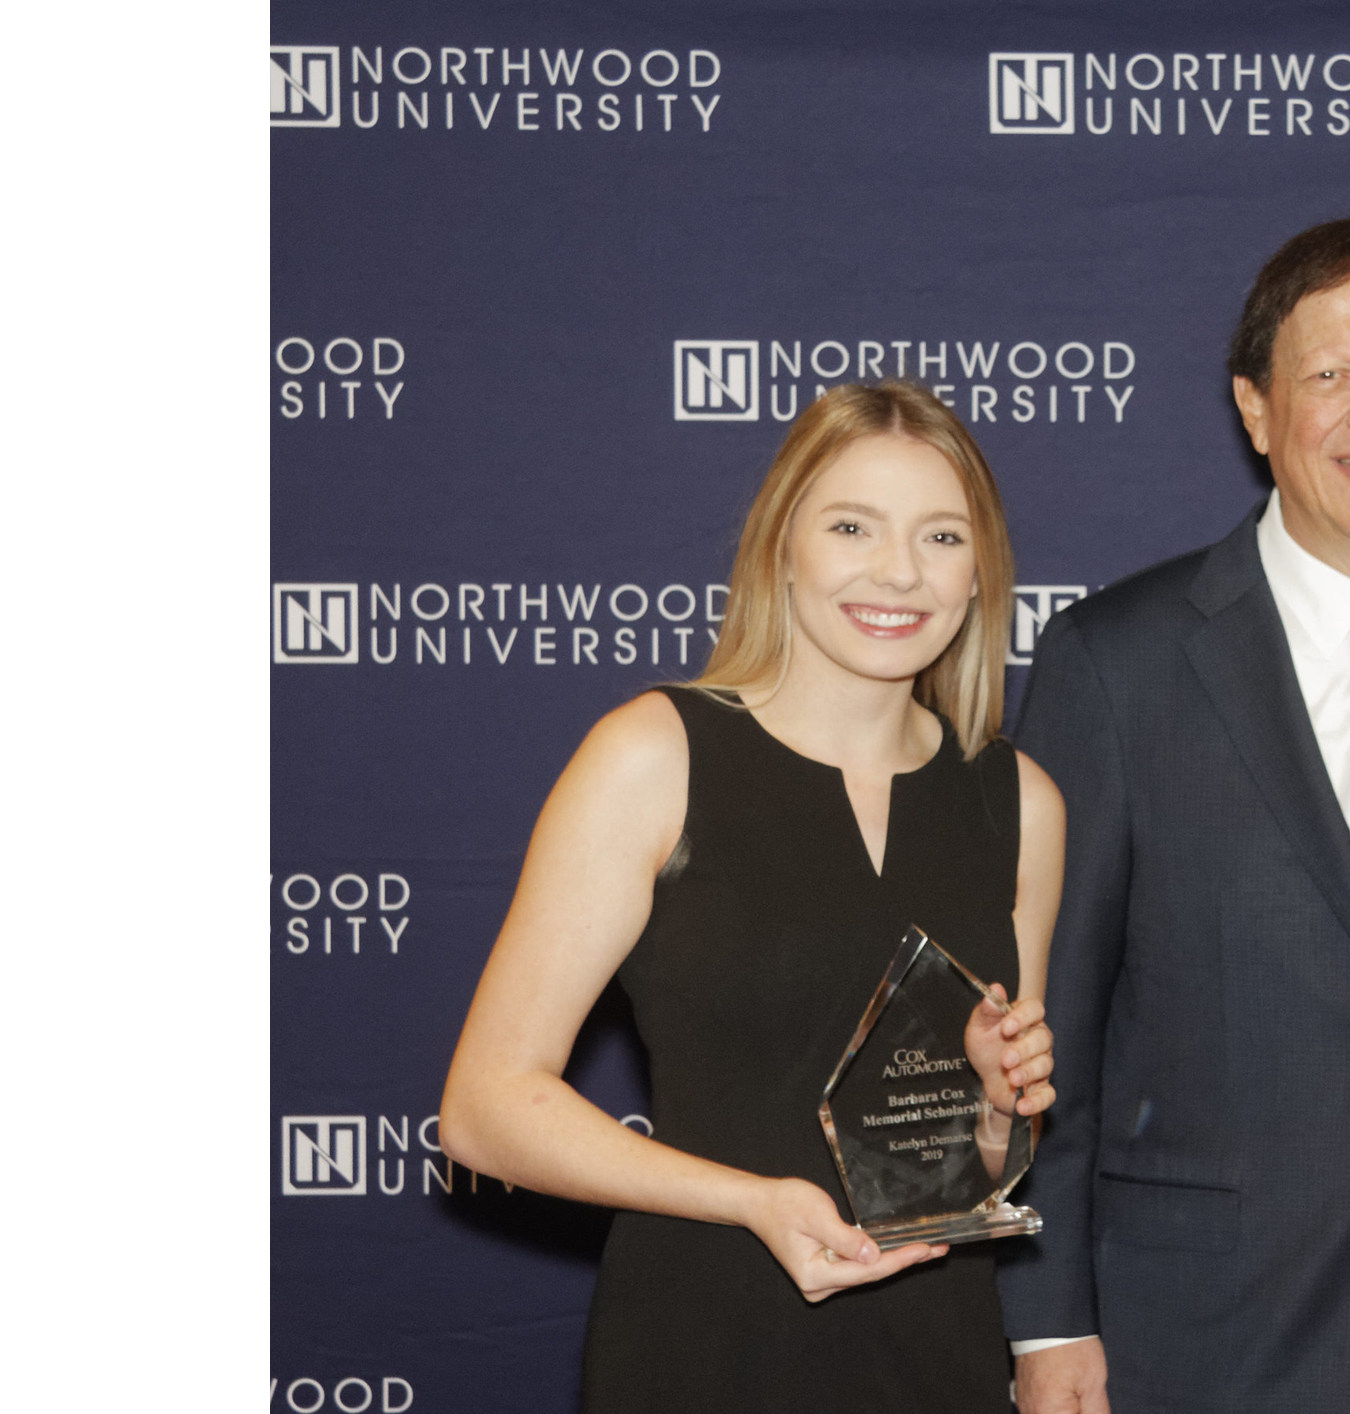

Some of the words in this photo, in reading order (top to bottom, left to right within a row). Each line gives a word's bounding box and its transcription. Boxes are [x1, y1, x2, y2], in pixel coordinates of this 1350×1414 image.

[352, 45, 721, 88] NORTHWOOD
[352, 90, 721, 133] UNIVERSITY
[275, 336, 405, 376] OOD
[770, 340, 1136, 380] NORTHWOOD
[280, 380, 404, 420] SITY
[370, 583, 732, 622] NORTHWOOD
[270, 873, 411, 911] OOD
[888, 1093, 938, 1107] Barbara
[941, 1088, 966, 1101] Cox
[862, 1110, 922, 1128] Memorial
[920, 1149, 944, 1161] 2019
